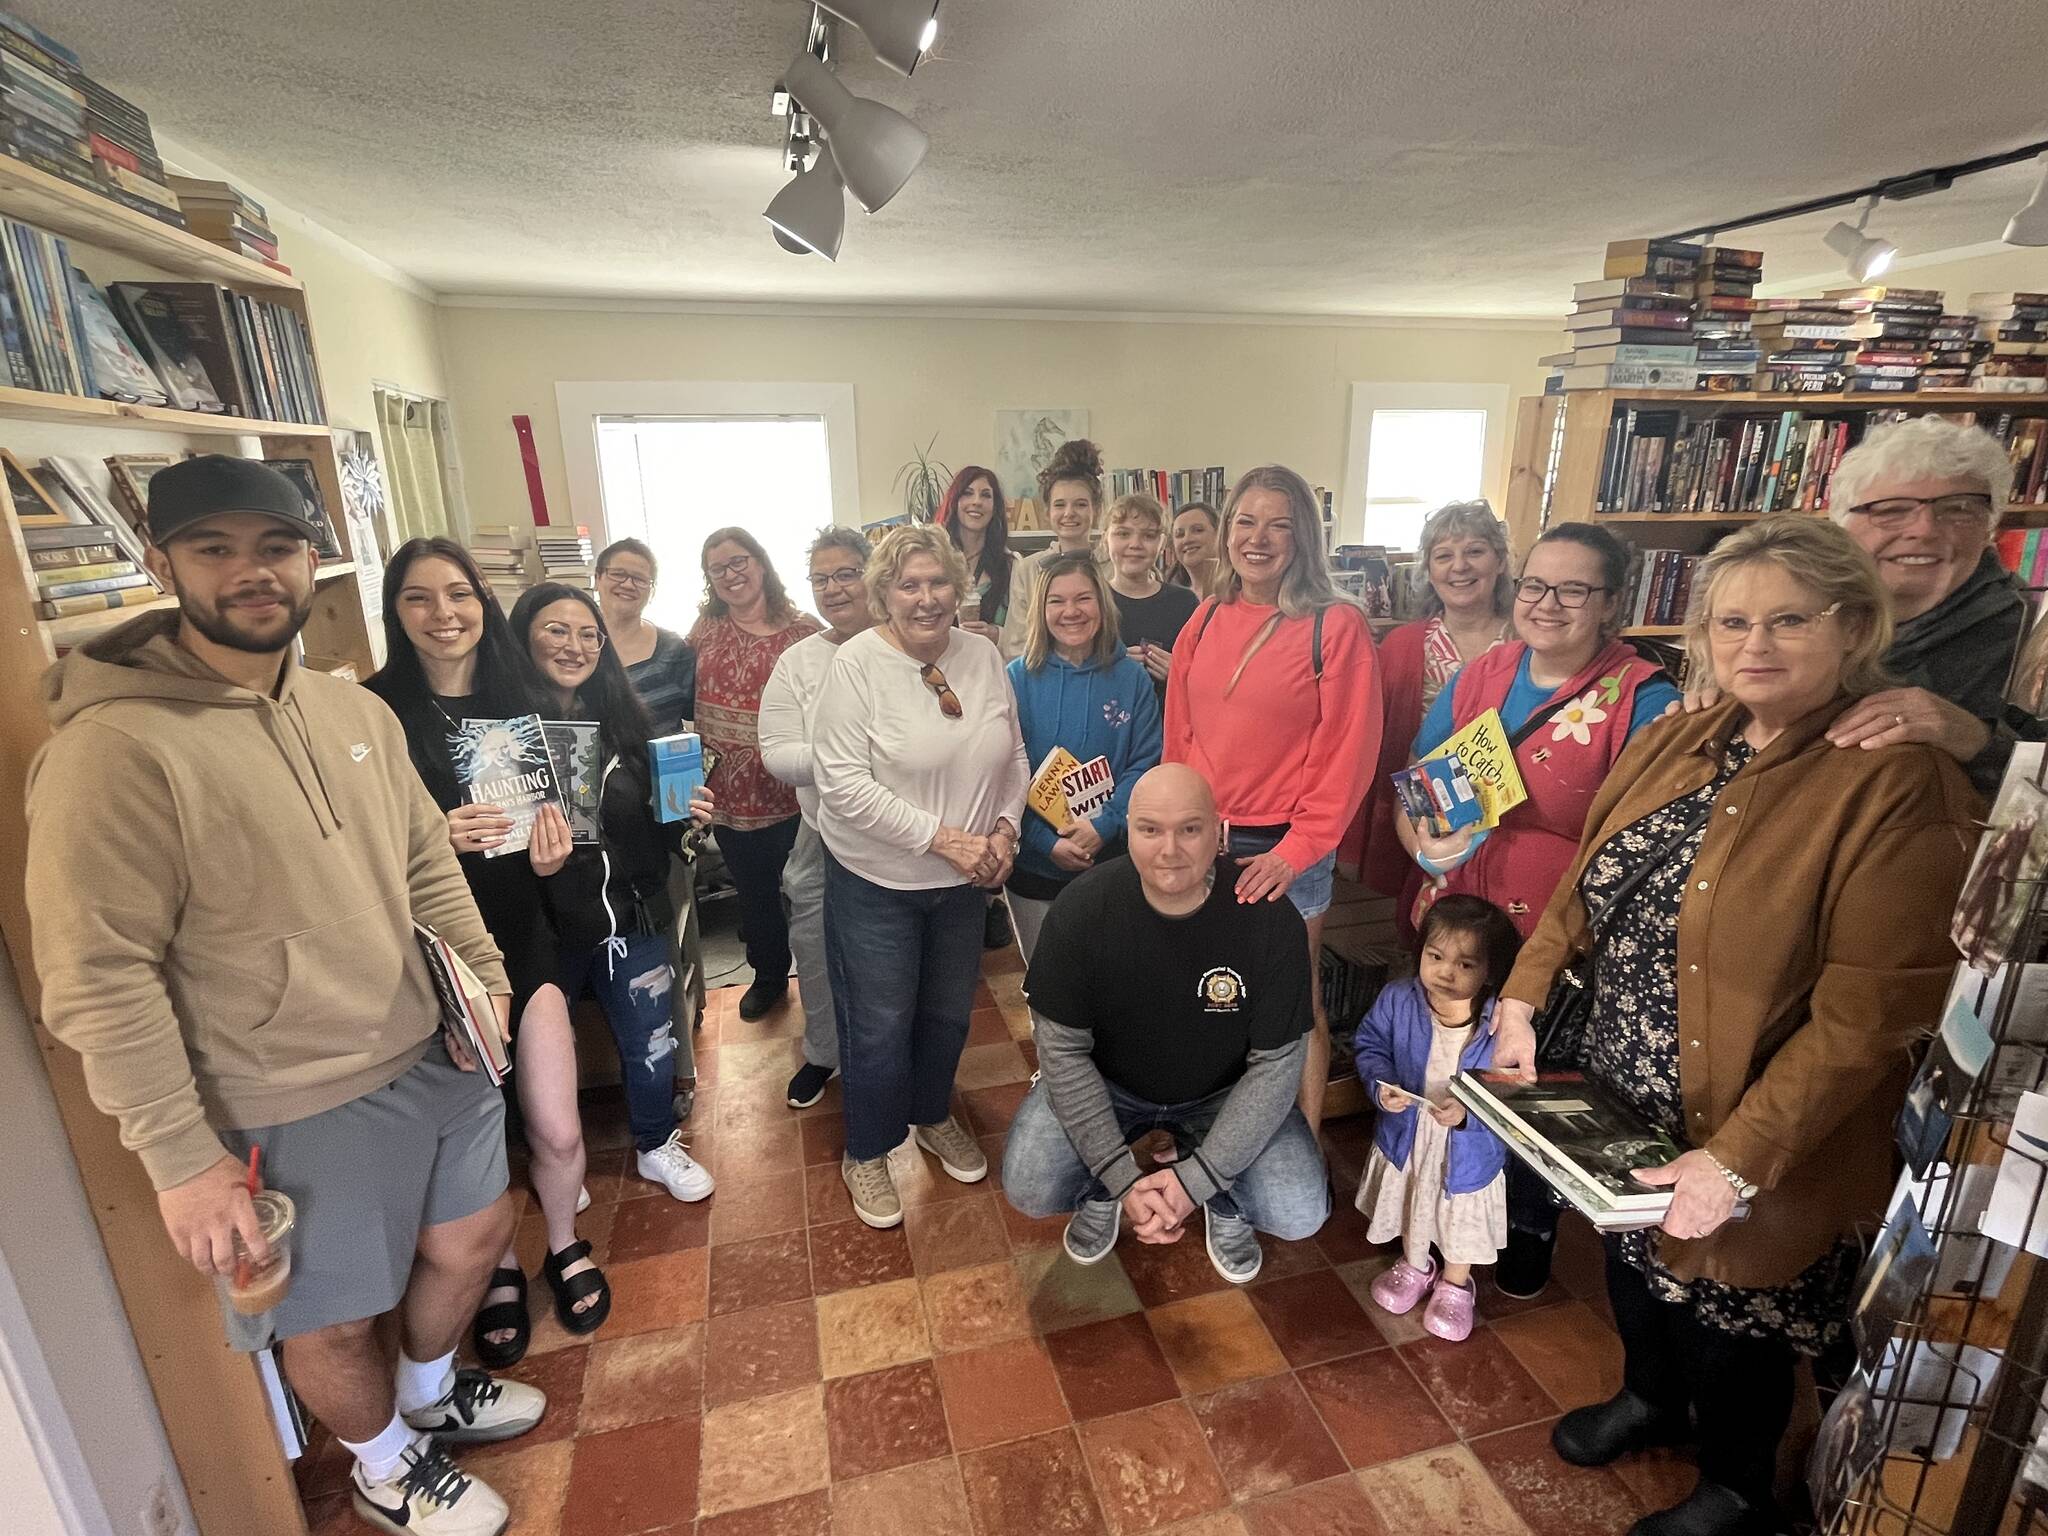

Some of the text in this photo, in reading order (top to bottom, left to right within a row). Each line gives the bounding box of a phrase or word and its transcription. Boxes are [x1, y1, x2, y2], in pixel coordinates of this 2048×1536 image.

[1471, 724, 1498, 753] How
[468, 767, 550, 804] HAUNTING
[1035, 757, 1065, 799] JENNY
[1038, 760, 1078, 812] LAWN
[1062, 757, 1110, 797] START
[1456, 741, 1469, 758] to
[1469, 749, 1504, 784] Catch
[1496, 783, 1506, 791] a
